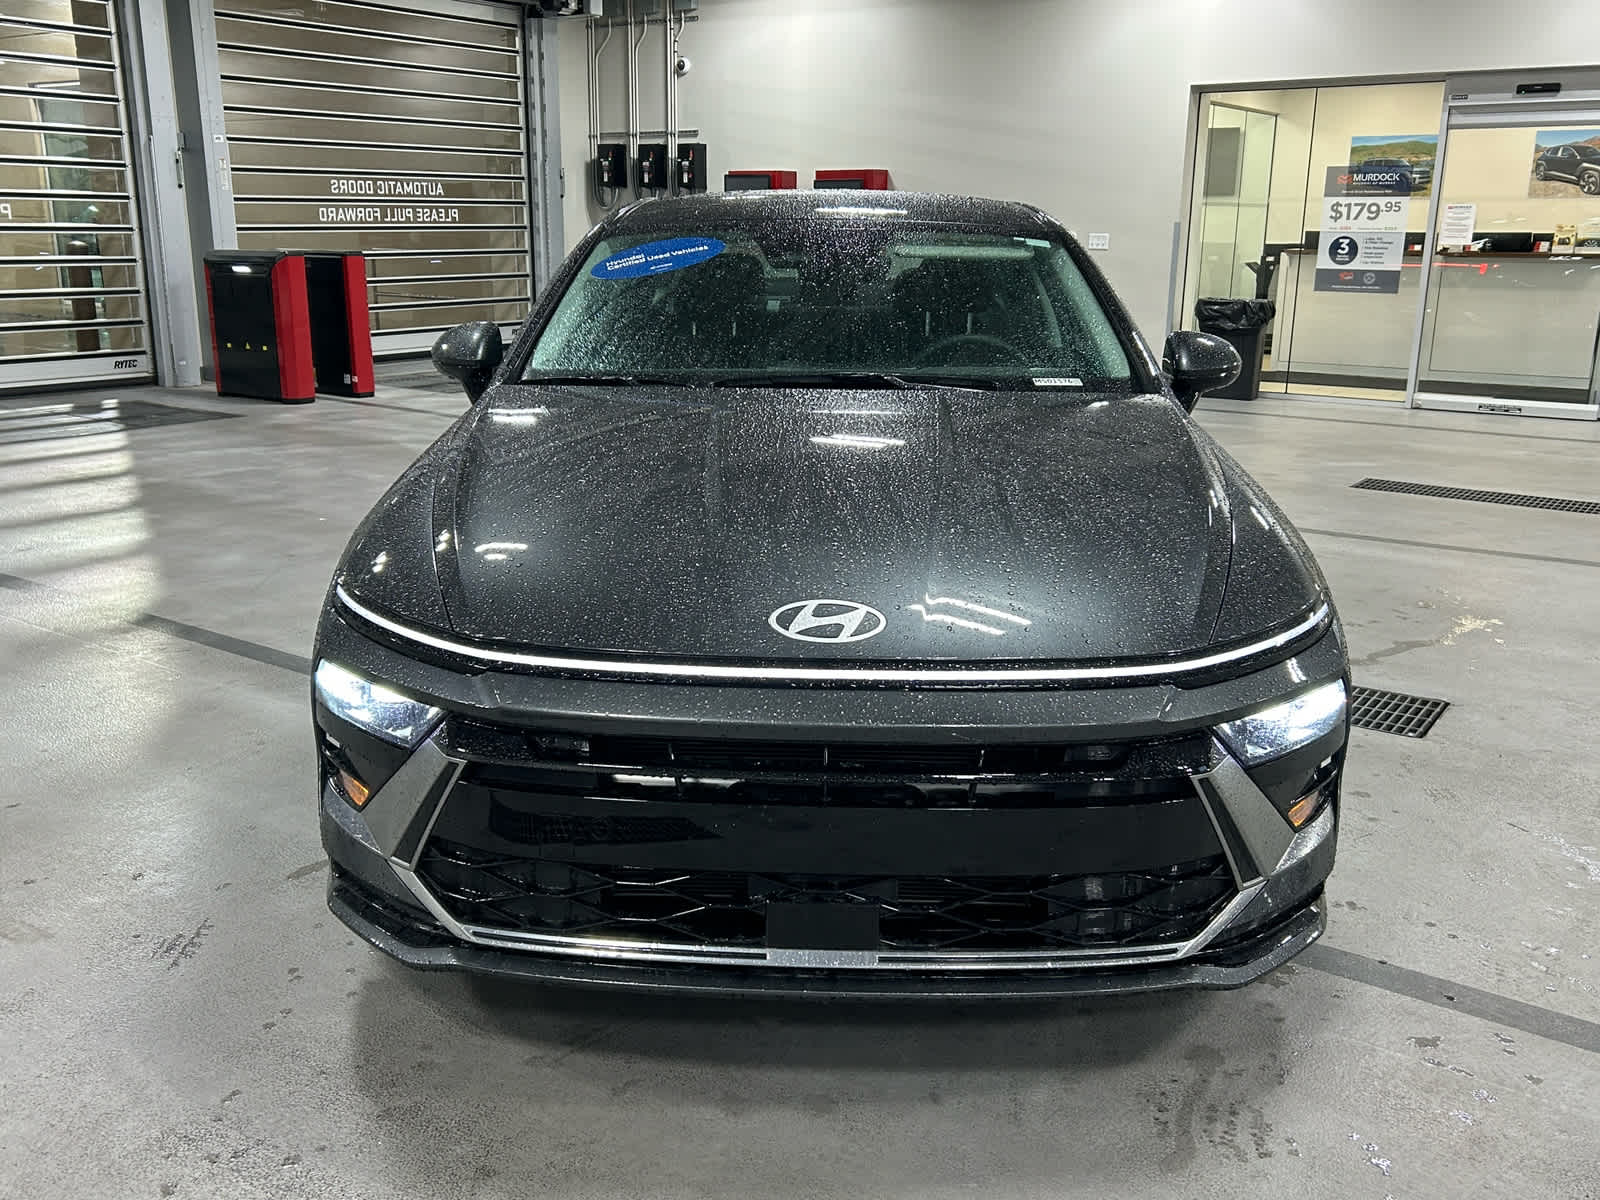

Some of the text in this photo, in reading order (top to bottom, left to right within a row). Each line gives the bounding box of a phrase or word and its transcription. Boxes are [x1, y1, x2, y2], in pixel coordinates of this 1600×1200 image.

[1352, 173, 1400, 182] MURDOCK
[1336, 238, 1350, 255] 3
[113, 359, 138, 369] RYTEC
